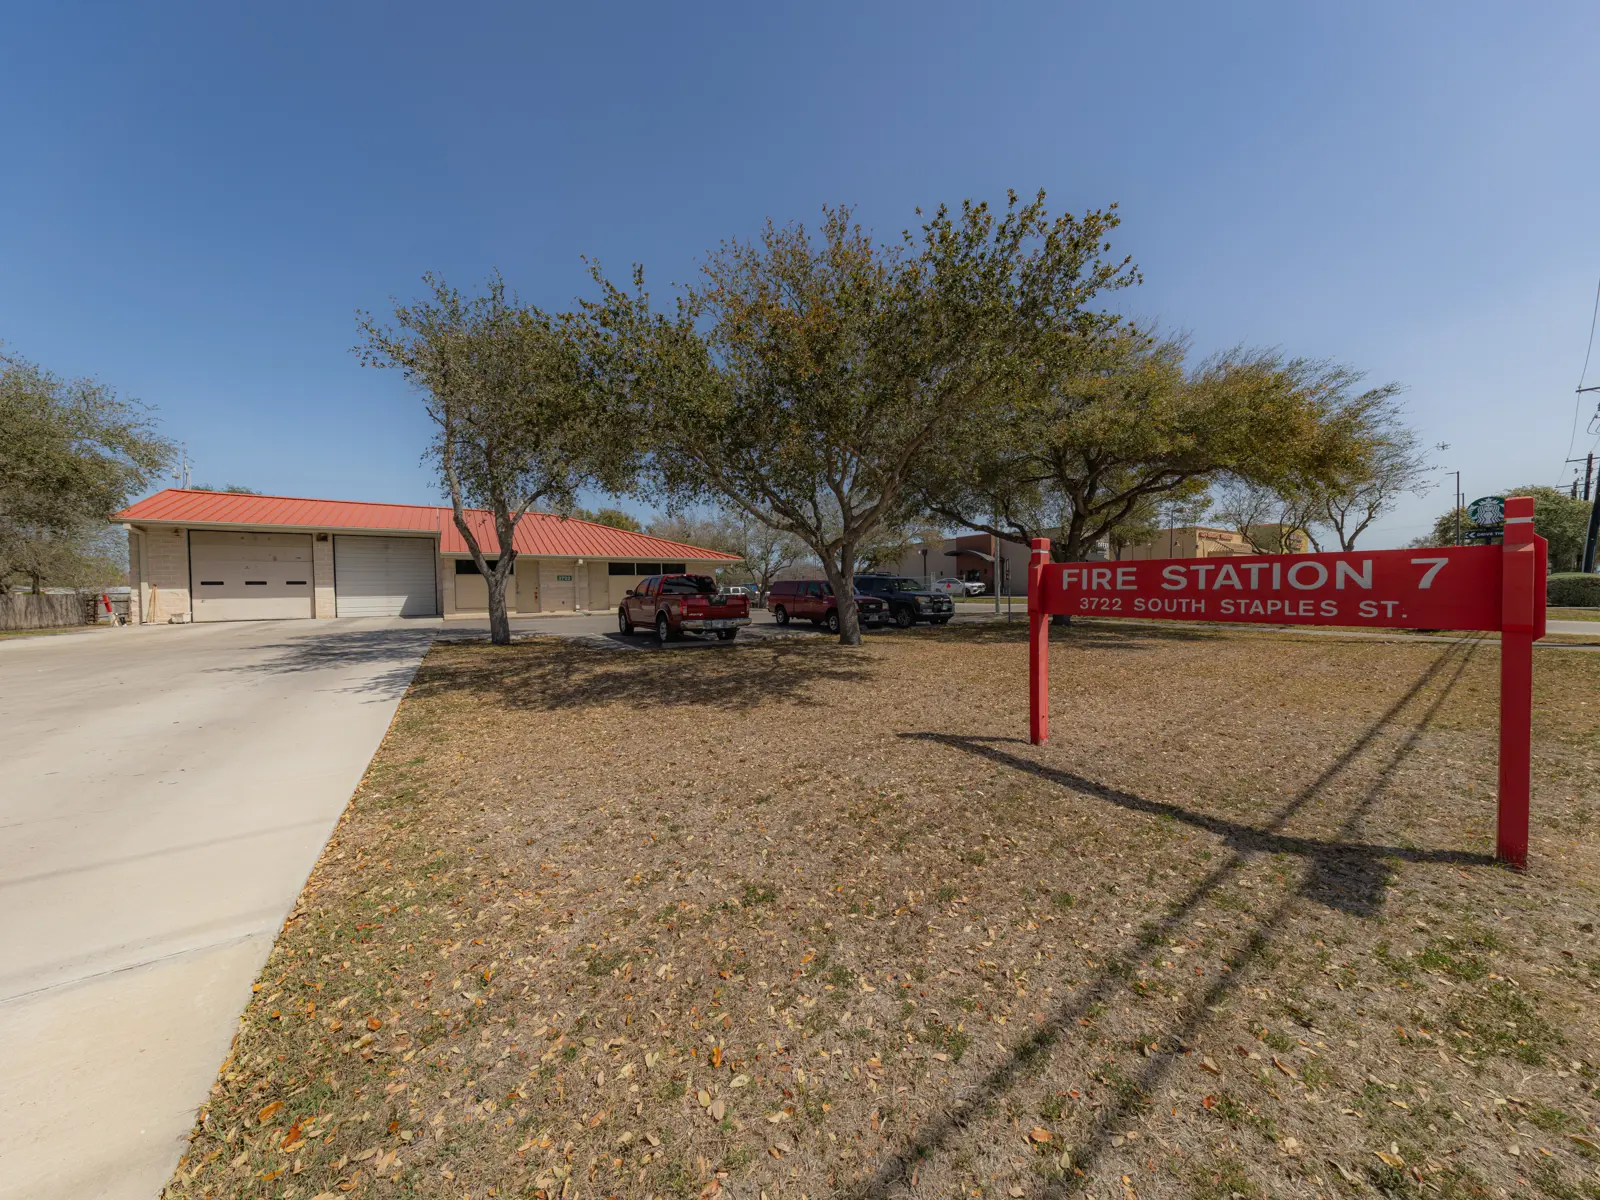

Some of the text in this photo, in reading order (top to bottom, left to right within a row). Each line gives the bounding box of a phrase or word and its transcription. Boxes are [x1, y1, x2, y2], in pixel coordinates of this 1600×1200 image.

[1062, 557, 1449, 590] FIRE STATION 7
[1079, 597, 1408, 618] 3722 SOUTH STAPLES ST.
